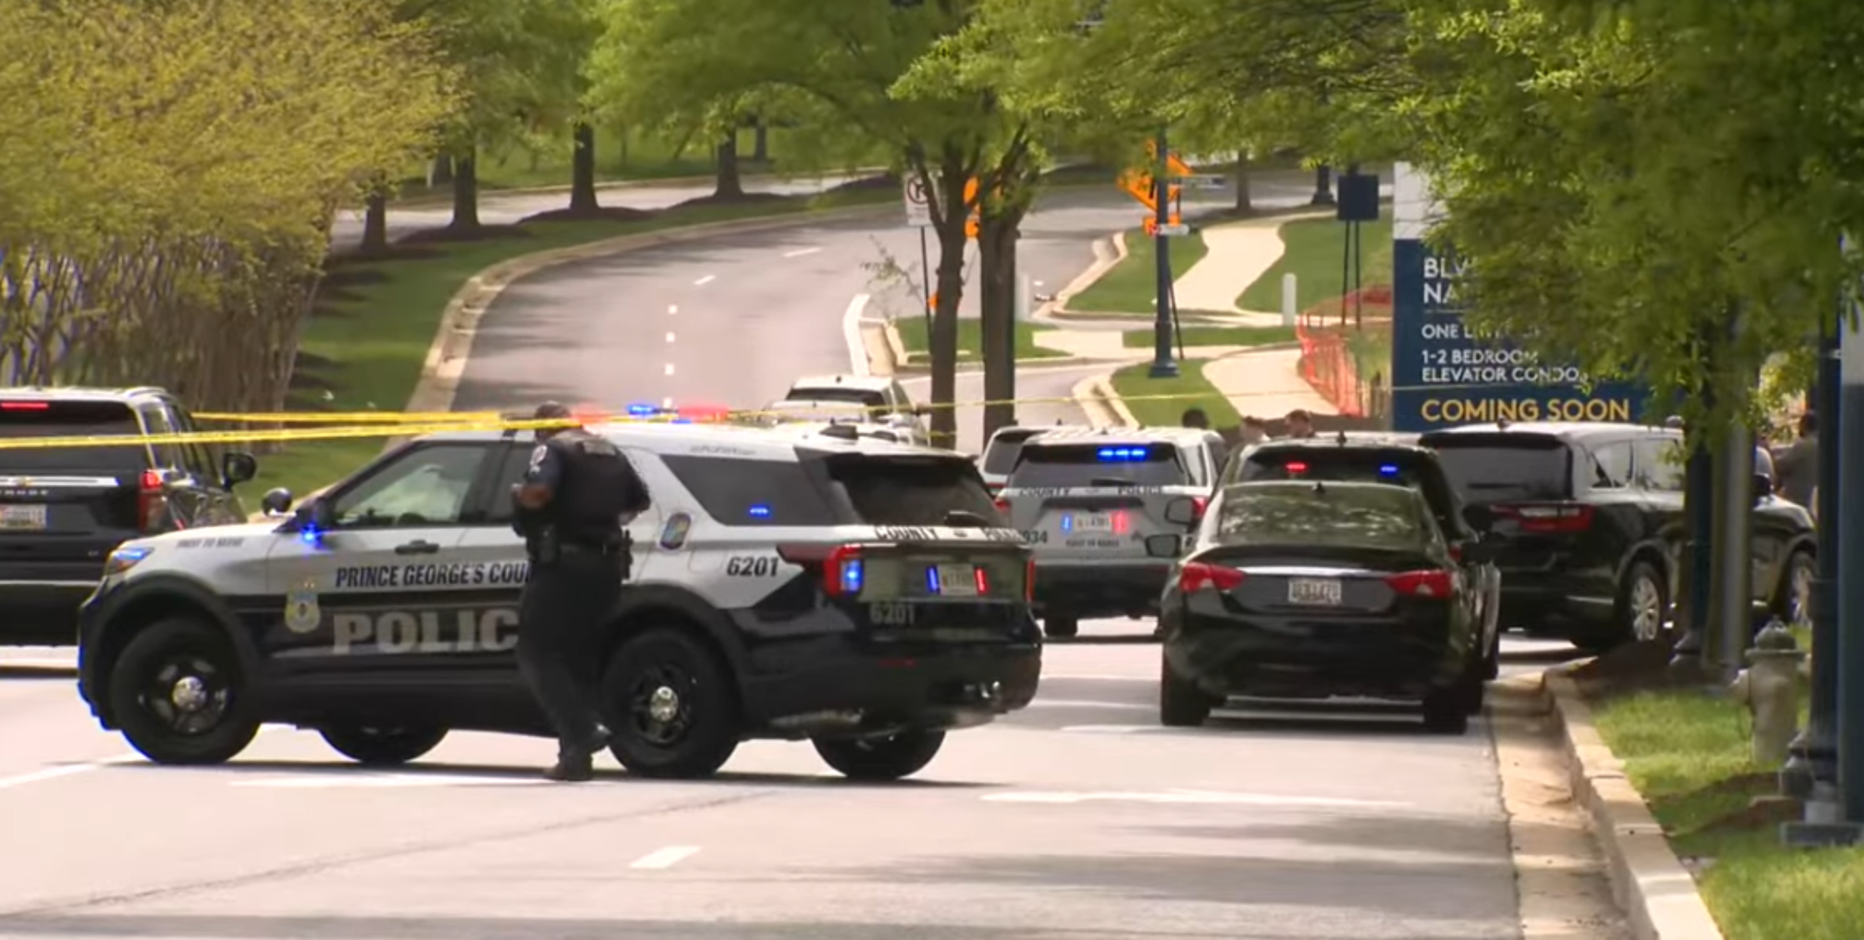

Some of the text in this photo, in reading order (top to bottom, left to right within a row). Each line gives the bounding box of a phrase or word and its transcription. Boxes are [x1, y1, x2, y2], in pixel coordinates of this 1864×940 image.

[1423, 257, 1470, 279] BLV
[1421, 324, 1459, 339] ONE
[1421, 350, 1447, 364] 1-2
[1422, 368, 1507, 382] ELEVATOR
[1421, 399, 1629, 422] COMING SOON
[1021, 529, 1048, 544] 934
[335, 561, 531, 588] PRINCE GEORGE'S COU
[726, 555, 780, 578] 6201
[869, 601, 917, 626] 6201
[332, 608, 520, 655] POLIC
